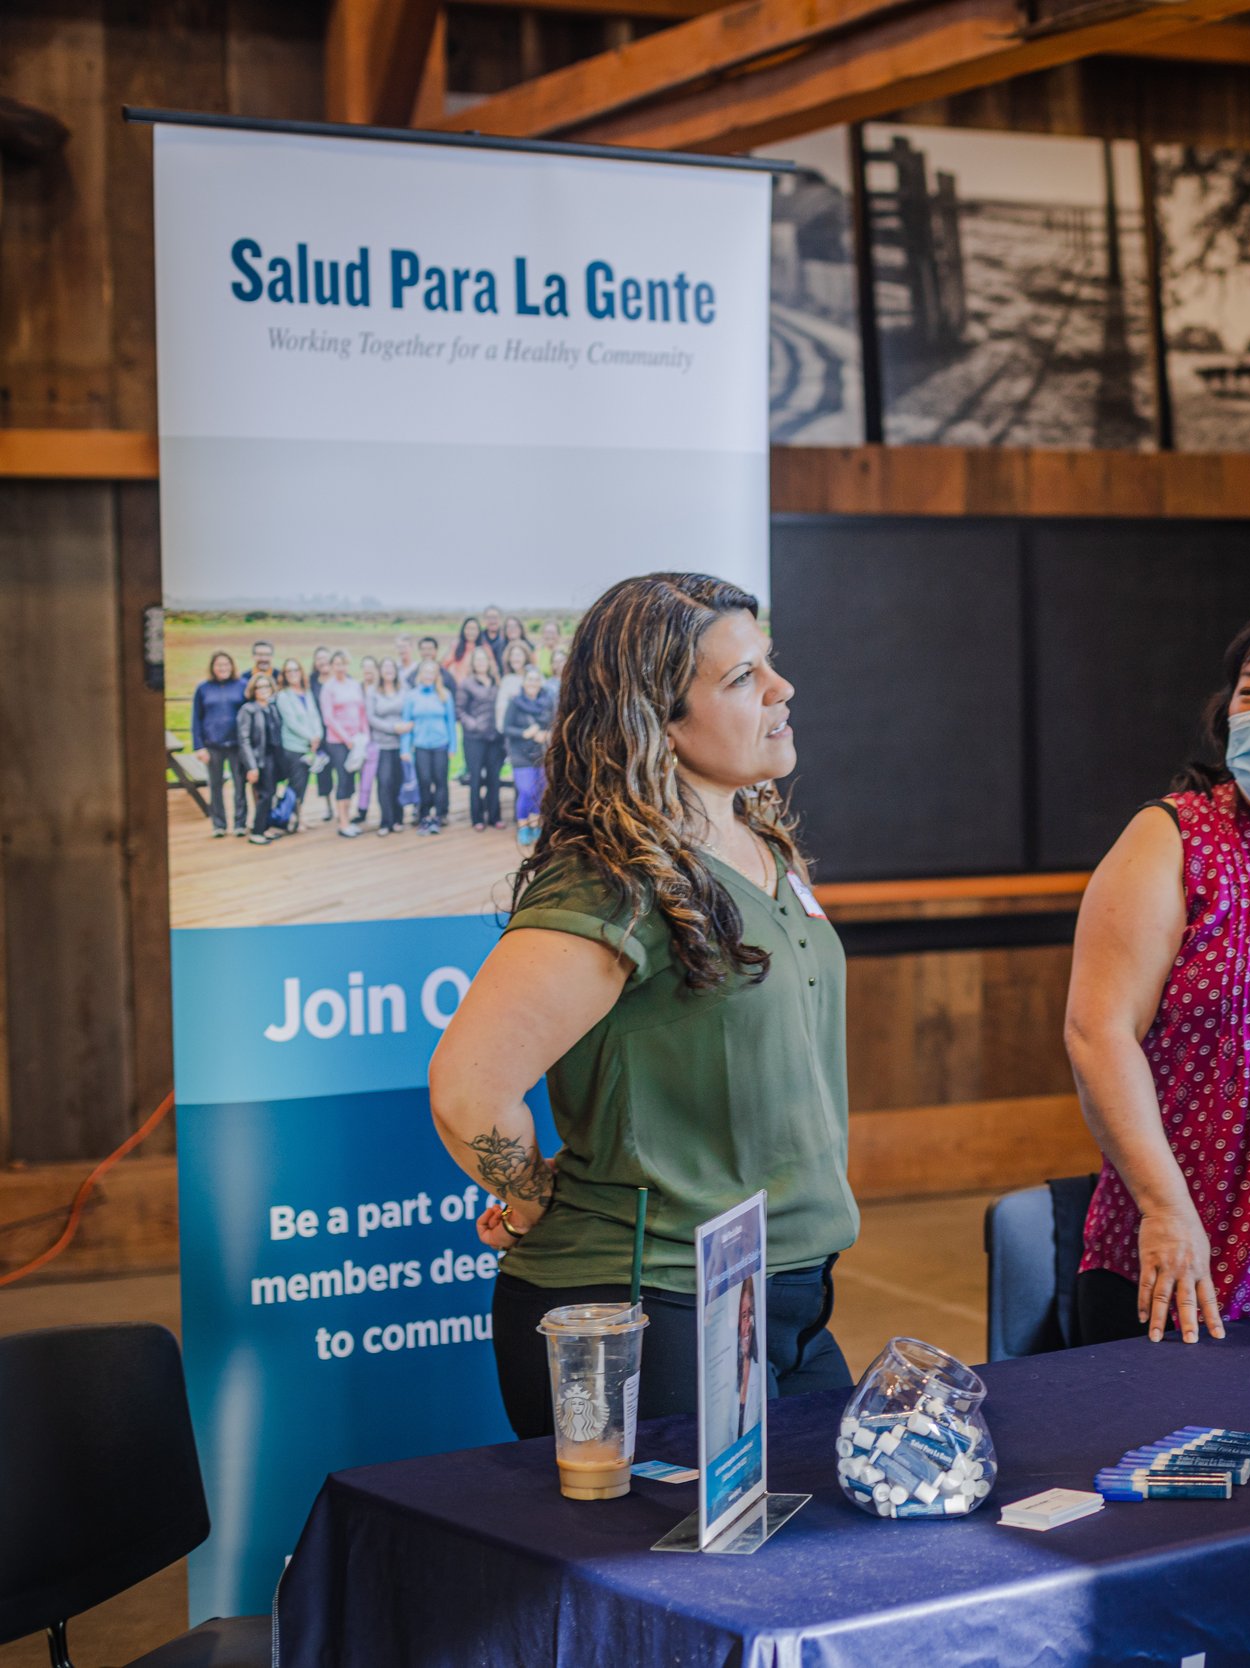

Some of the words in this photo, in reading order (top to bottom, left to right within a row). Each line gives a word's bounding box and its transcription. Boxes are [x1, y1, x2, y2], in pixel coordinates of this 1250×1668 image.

[230, 237, 371, 308] Salud
[389, 248, 499, 314] Para
[513, 255, 570, 318] La
[584, 260, 718, 326] Gente
[267, 327, 351, 360] Working
[358, 330, 446, 362] Together
[448, 335, 480, 365] for
[484, 343, 499, 361] a
[503, 337, 580, 370] Healthy
[587, 341, 694, 374] Community
[263, 971, 407, 1042] Join
[421, 966, 474, 1030] O
[269, 1204, 319, 1241] Be
[326, 1206, 349, 1234] a
[357, 1197, 432, 1237] part
[440, 1184, 479, 1222] of
[251, 1260, 422, 1305] members
[430, 1248, 507, 1284] dee
[315, 1327, 355, 1360] to
[362, 1313, 494, 1354] commu
